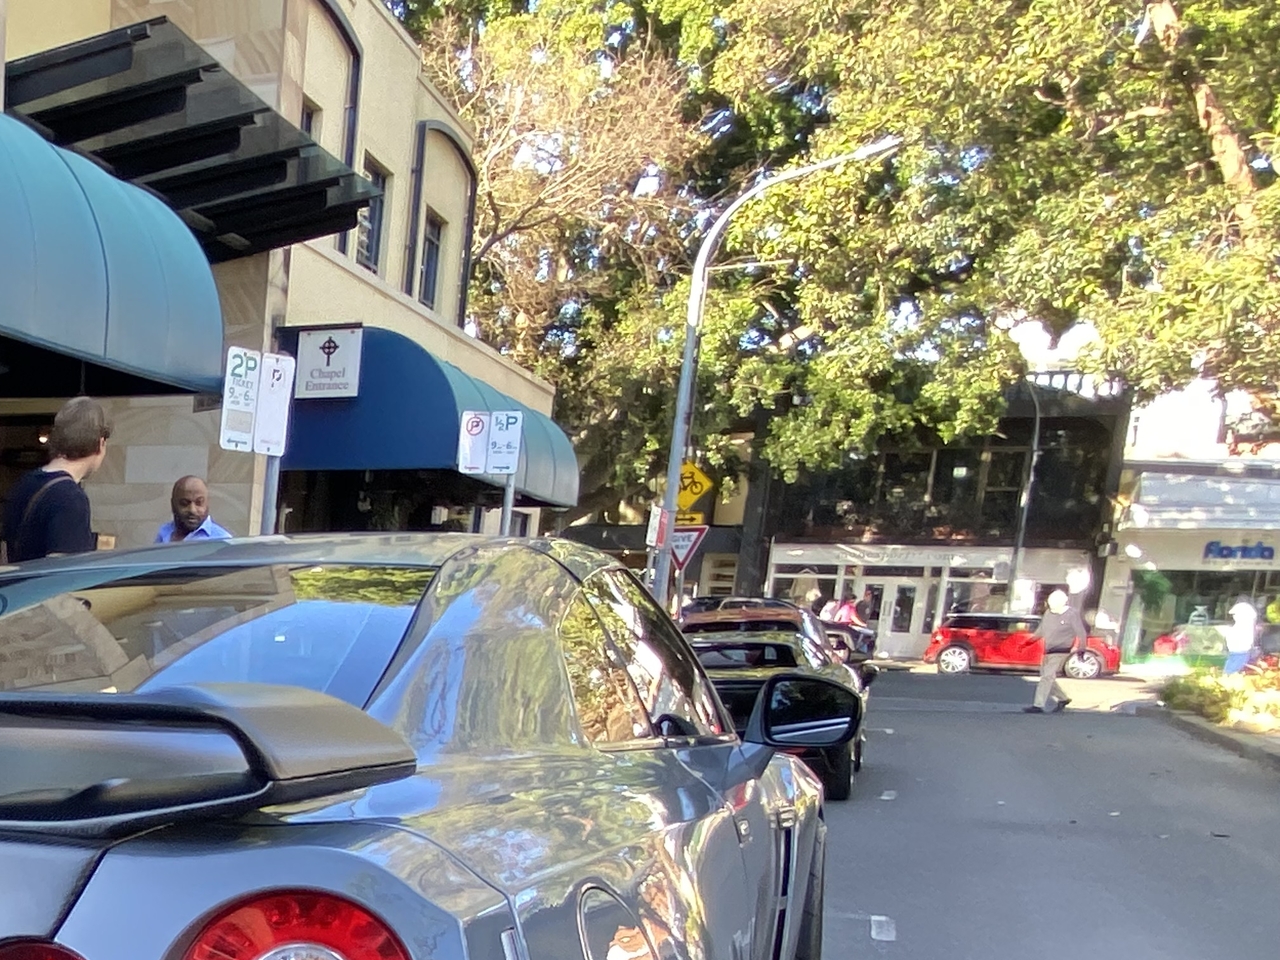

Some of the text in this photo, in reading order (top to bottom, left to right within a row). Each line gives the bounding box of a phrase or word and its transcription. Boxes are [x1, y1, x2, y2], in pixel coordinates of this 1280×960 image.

[231, 354, 257, 378] 2P
[310, 367, 346, 381] Chapel
[305, 380, 349, 391] Entrance
